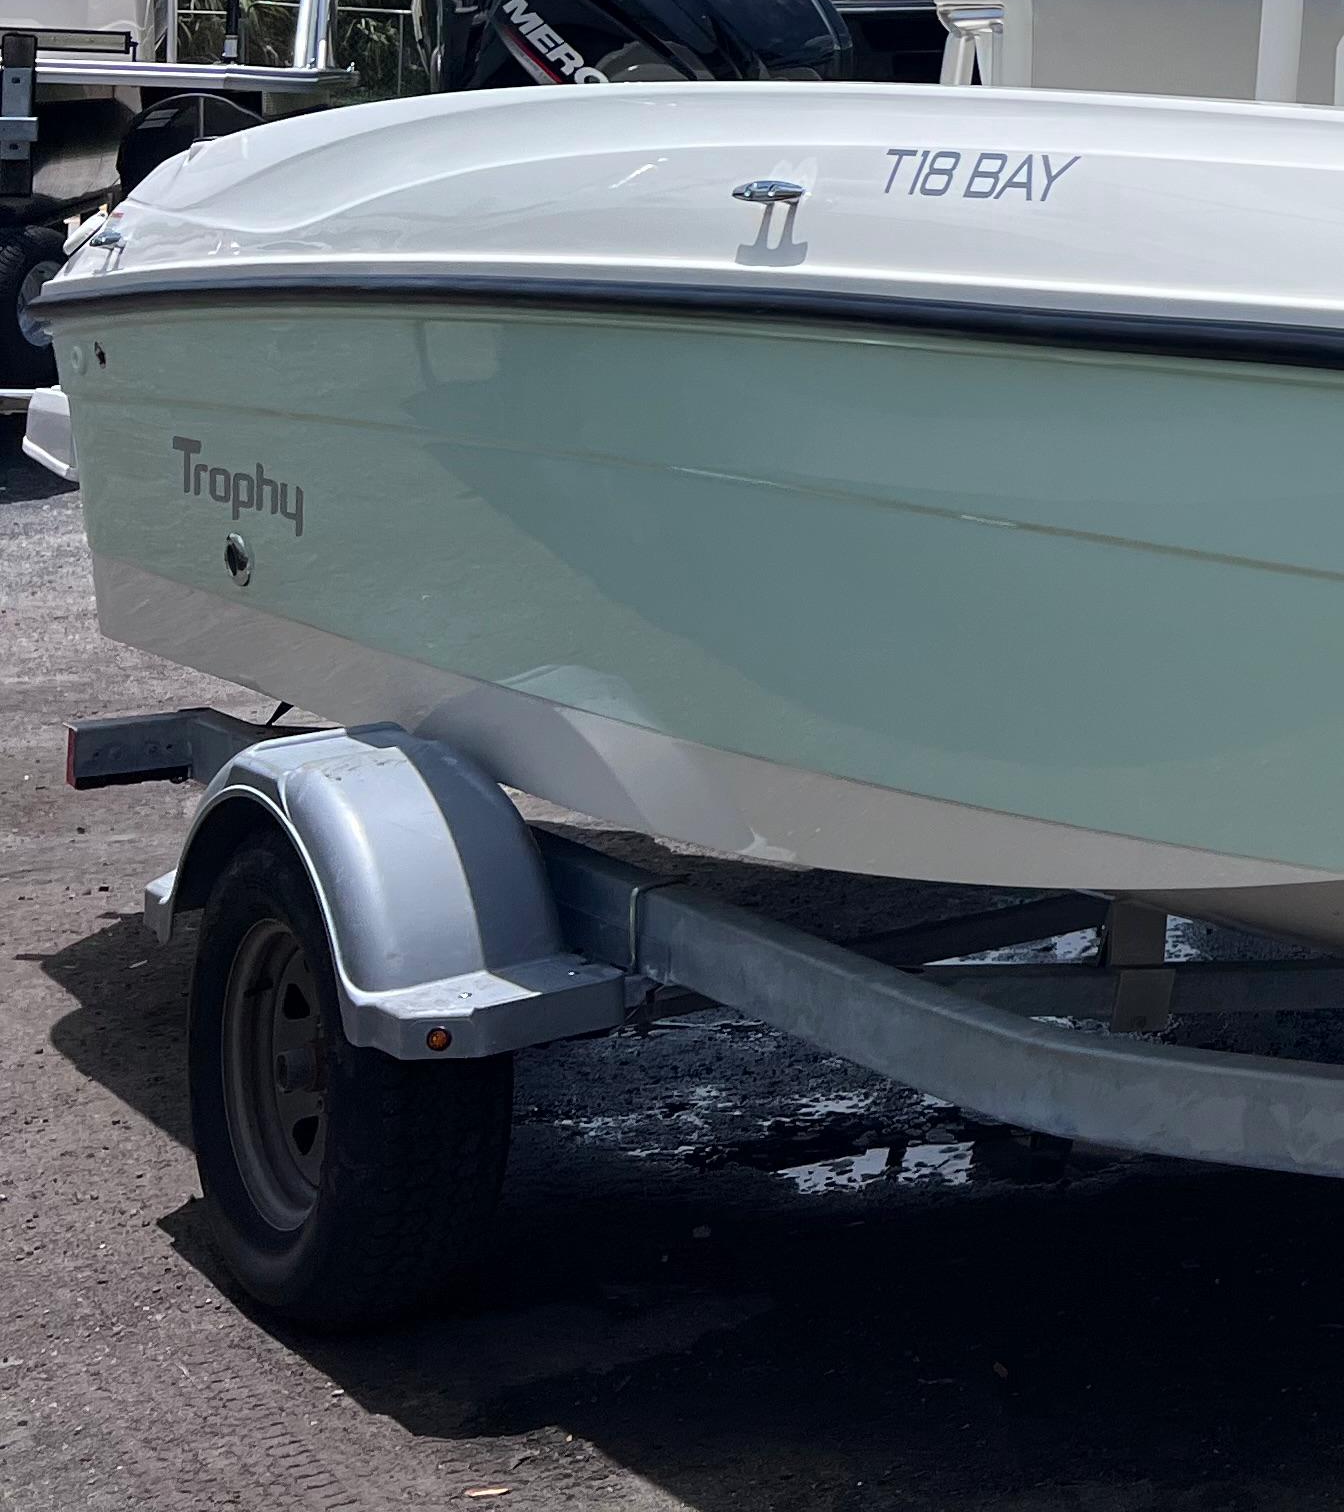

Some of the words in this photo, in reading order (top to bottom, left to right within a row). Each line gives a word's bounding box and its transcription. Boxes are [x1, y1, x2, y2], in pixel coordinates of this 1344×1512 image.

[884, 148, 962, 197] T18
[962, 152, 1083, 202] BAY
[172, 435, 304, 537] Trophy
